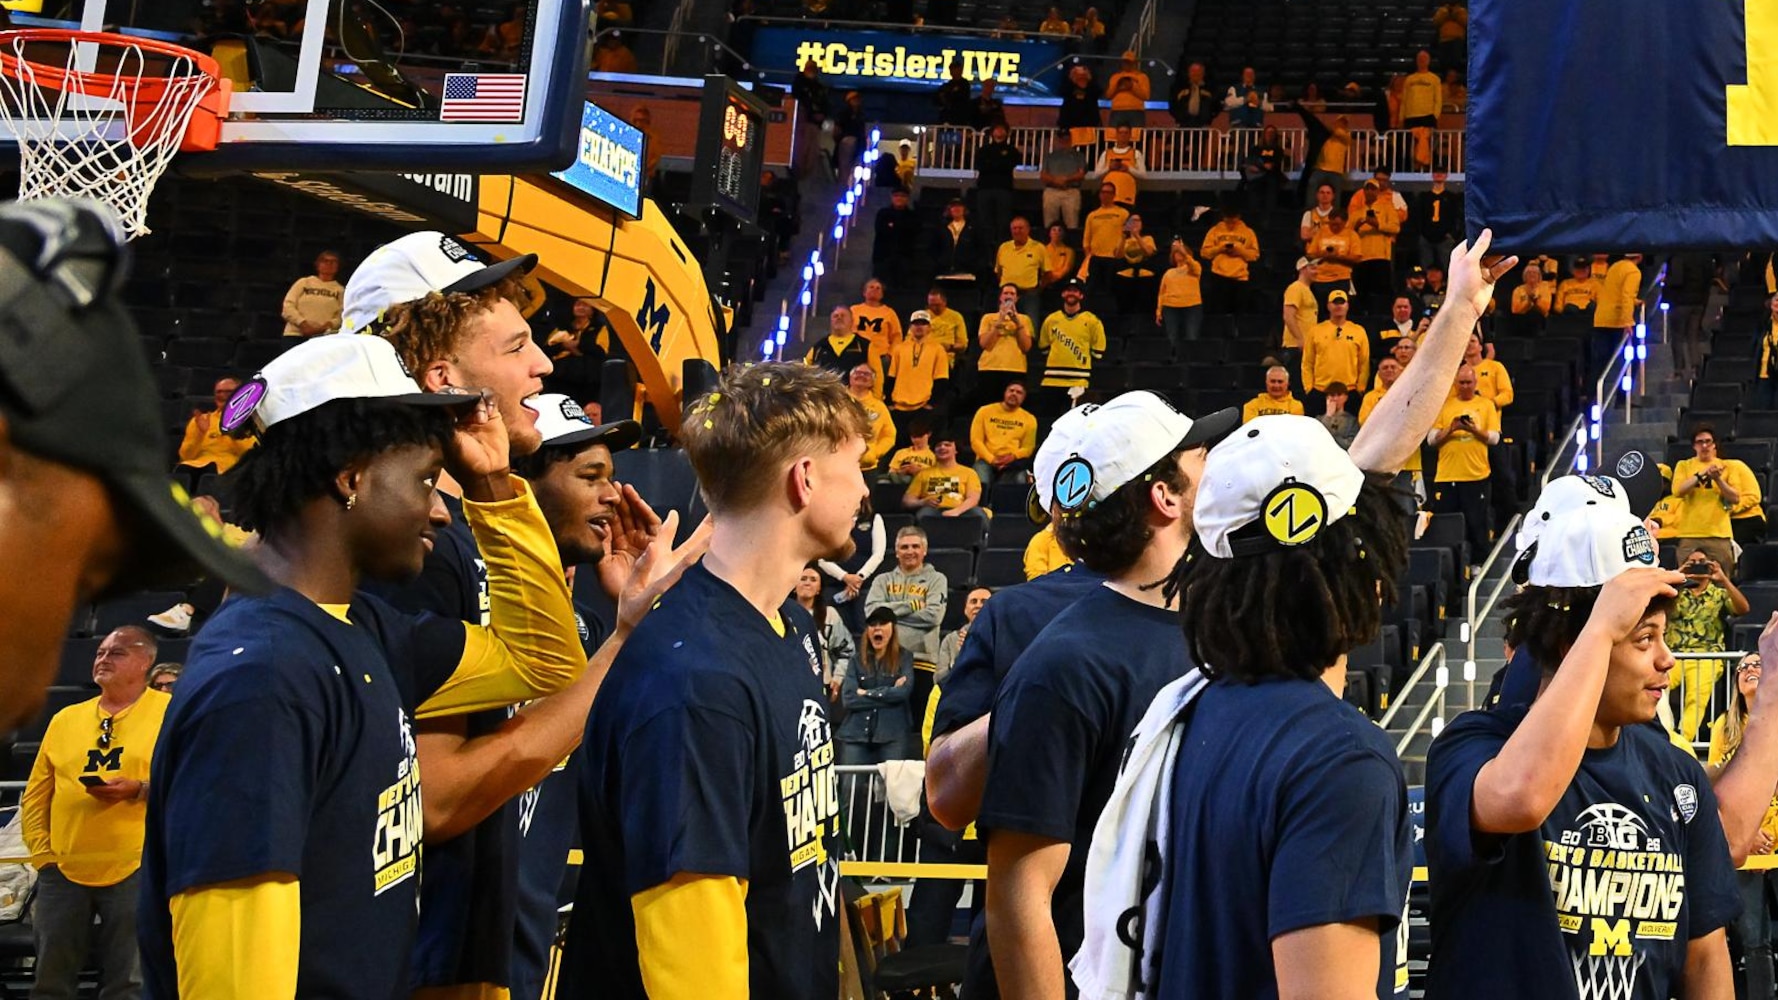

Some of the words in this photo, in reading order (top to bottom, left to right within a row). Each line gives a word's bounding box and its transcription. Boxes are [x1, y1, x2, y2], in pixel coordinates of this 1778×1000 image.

[580, 126, 639, 189] CHAMPS
[857, 316, 884, 333] M
[1050, 327, 1088, 365] MICHIGAN
[83, 746, 125, 772] M
[1561, 829, 1581, 846] 20
[1646, 838, 1661, 852] 26
[1589, 917, 1633, 957] M
